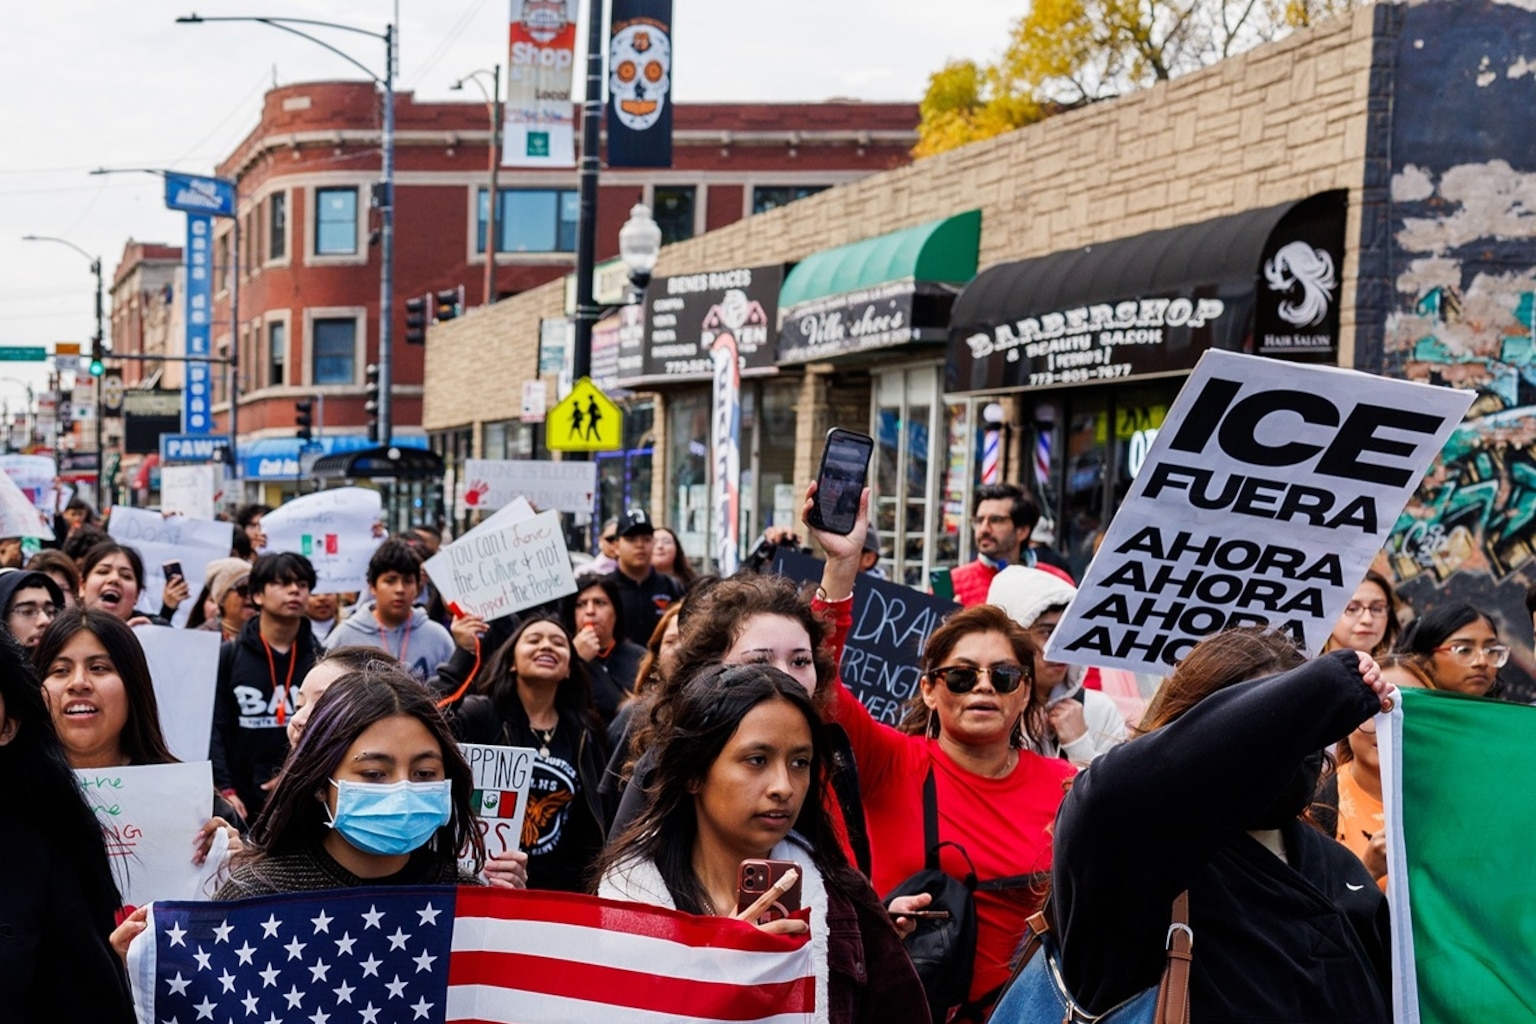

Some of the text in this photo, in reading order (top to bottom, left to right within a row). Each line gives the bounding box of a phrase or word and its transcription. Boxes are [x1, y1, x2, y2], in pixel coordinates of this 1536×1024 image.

[511, 42, 573, 70] Shop
[966, 299, 1224, 358] BARBERSHOP
[1169, 377, 1446, 489] ICE
[1140, 462, 1379, 535] FUERA
[1114, 526, 1345, 588] AHORA
[1097, 560, 1325, 619] AHORA
